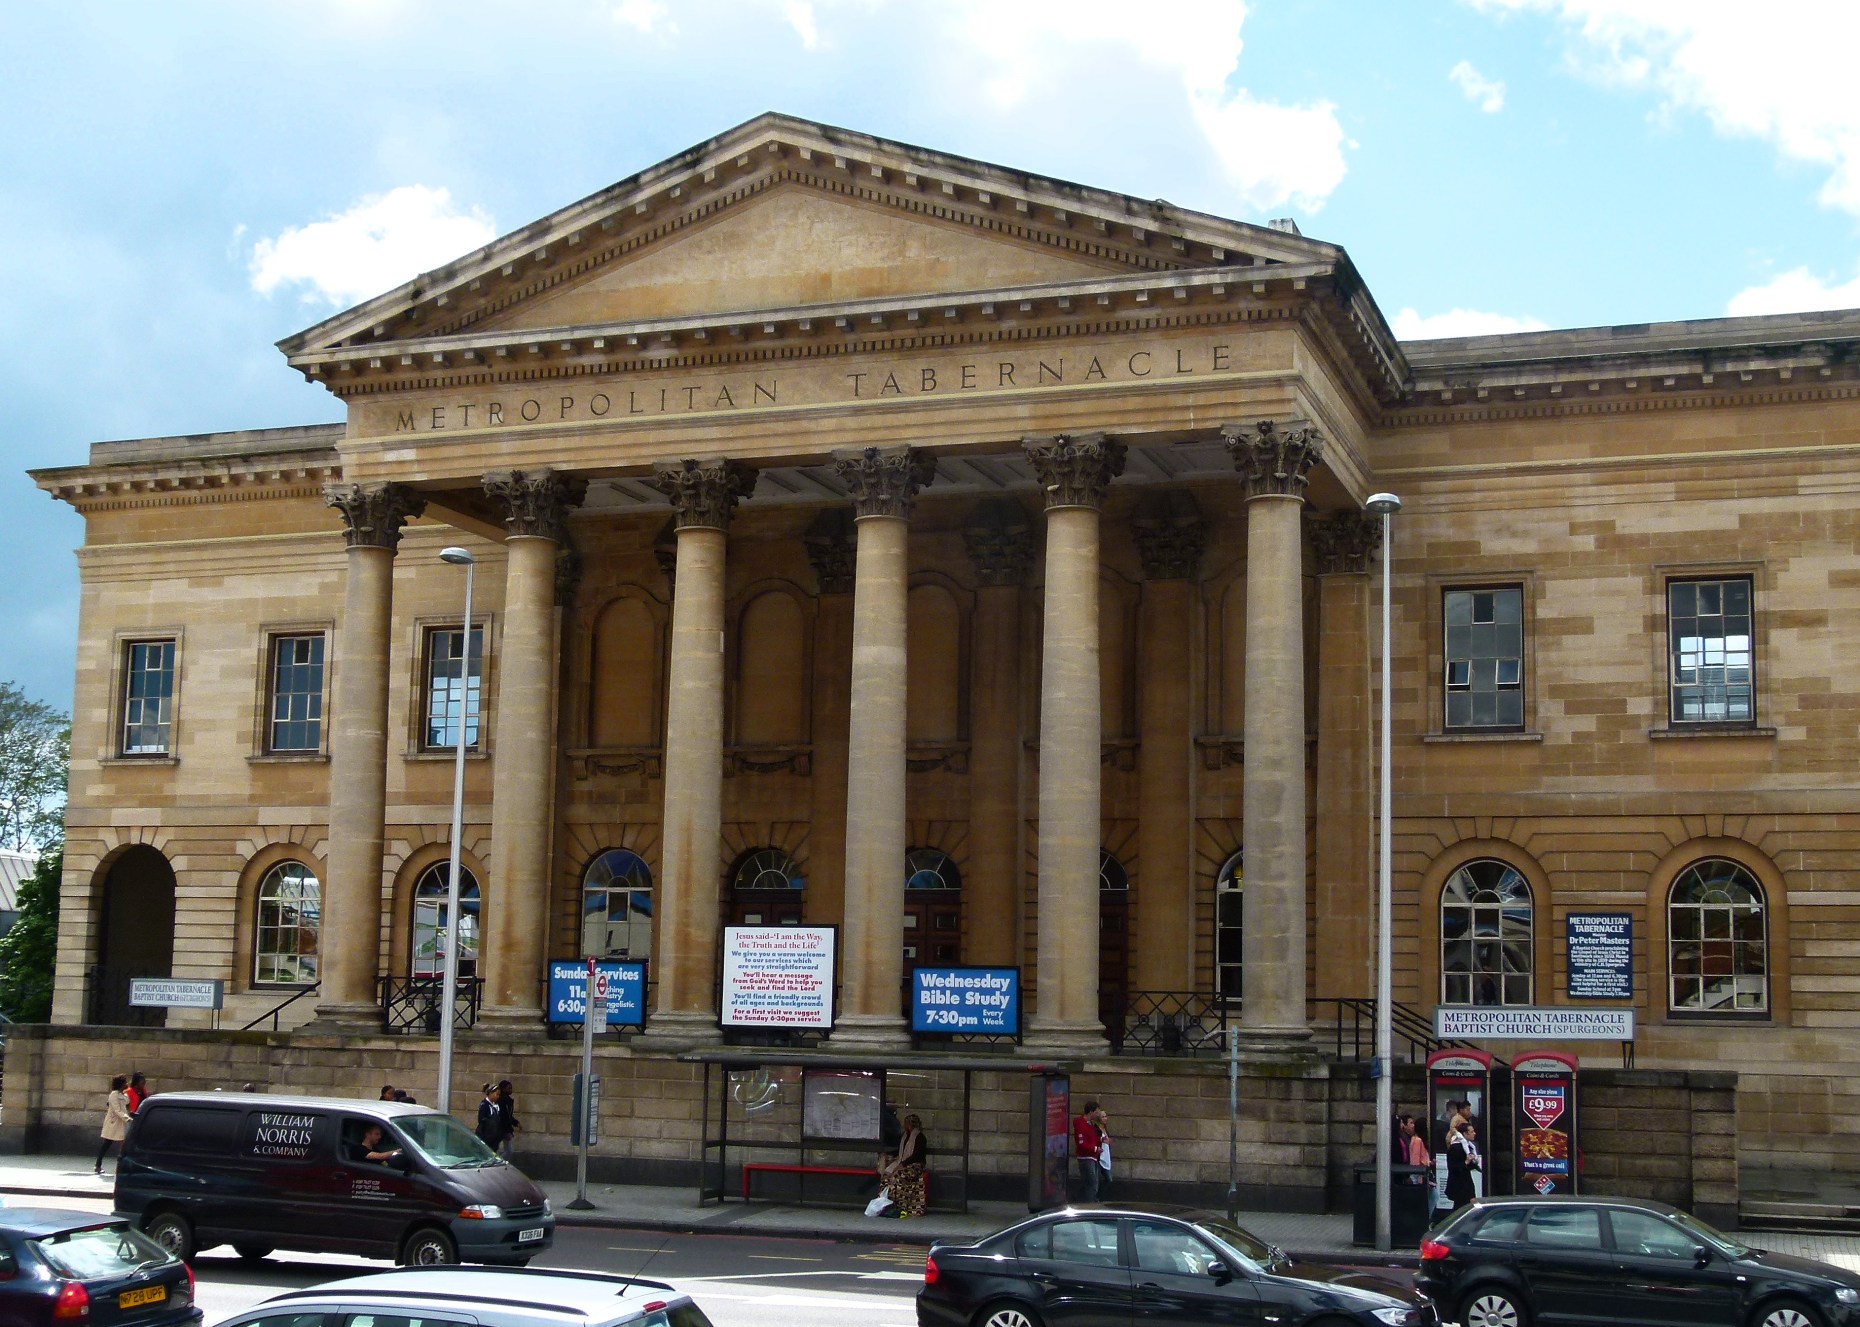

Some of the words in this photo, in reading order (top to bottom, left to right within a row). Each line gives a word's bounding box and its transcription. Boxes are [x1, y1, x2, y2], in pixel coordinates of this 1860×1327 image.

[395, 380, 778, 432] METROPOLITAN
[847, 345, 1230, 397] TABERNACLE
[1570, 917, 1629, 925] METROPOLITAN
[806, 933, 823, 942] Way,
[554, 967, 590, 979] Sunda
[920, 973, 1010, 992] Wednesday
[134, 984, 175, 992] METROPOLITAN
[176, 985, 211, 994] TABERNACLE
[569, 986, 586, 998] 11a
[155, 993, 179, 1001] CHURCH
[921, 990, 960, 1005] Bible
[965, 991, 1010, 1009] Study
[781, 1000, 823, 1008] backgrounds
[983, 1010, 1003, 1018] Every
[1444, 1012, 1541, 1023] METROPOLITAN
[1544, 1013, 1625, 1024] TABERNACLE
[1444, 1024, 1494, 1033] BAPTIST
[1497, 1024, 1551, 1034] CHURCH
[1553, 1024, 1625, 1034] (SPURGEON'S)
[1530, 1061, 1557, 1069] Telephone
[261, 1114, 314, 1128] WILLIAM
[256, 1128, 312, 1145] NORRIS
[253, 1145, 260, 1153] &
[262, 1145, 308, 1159] COMPANY
